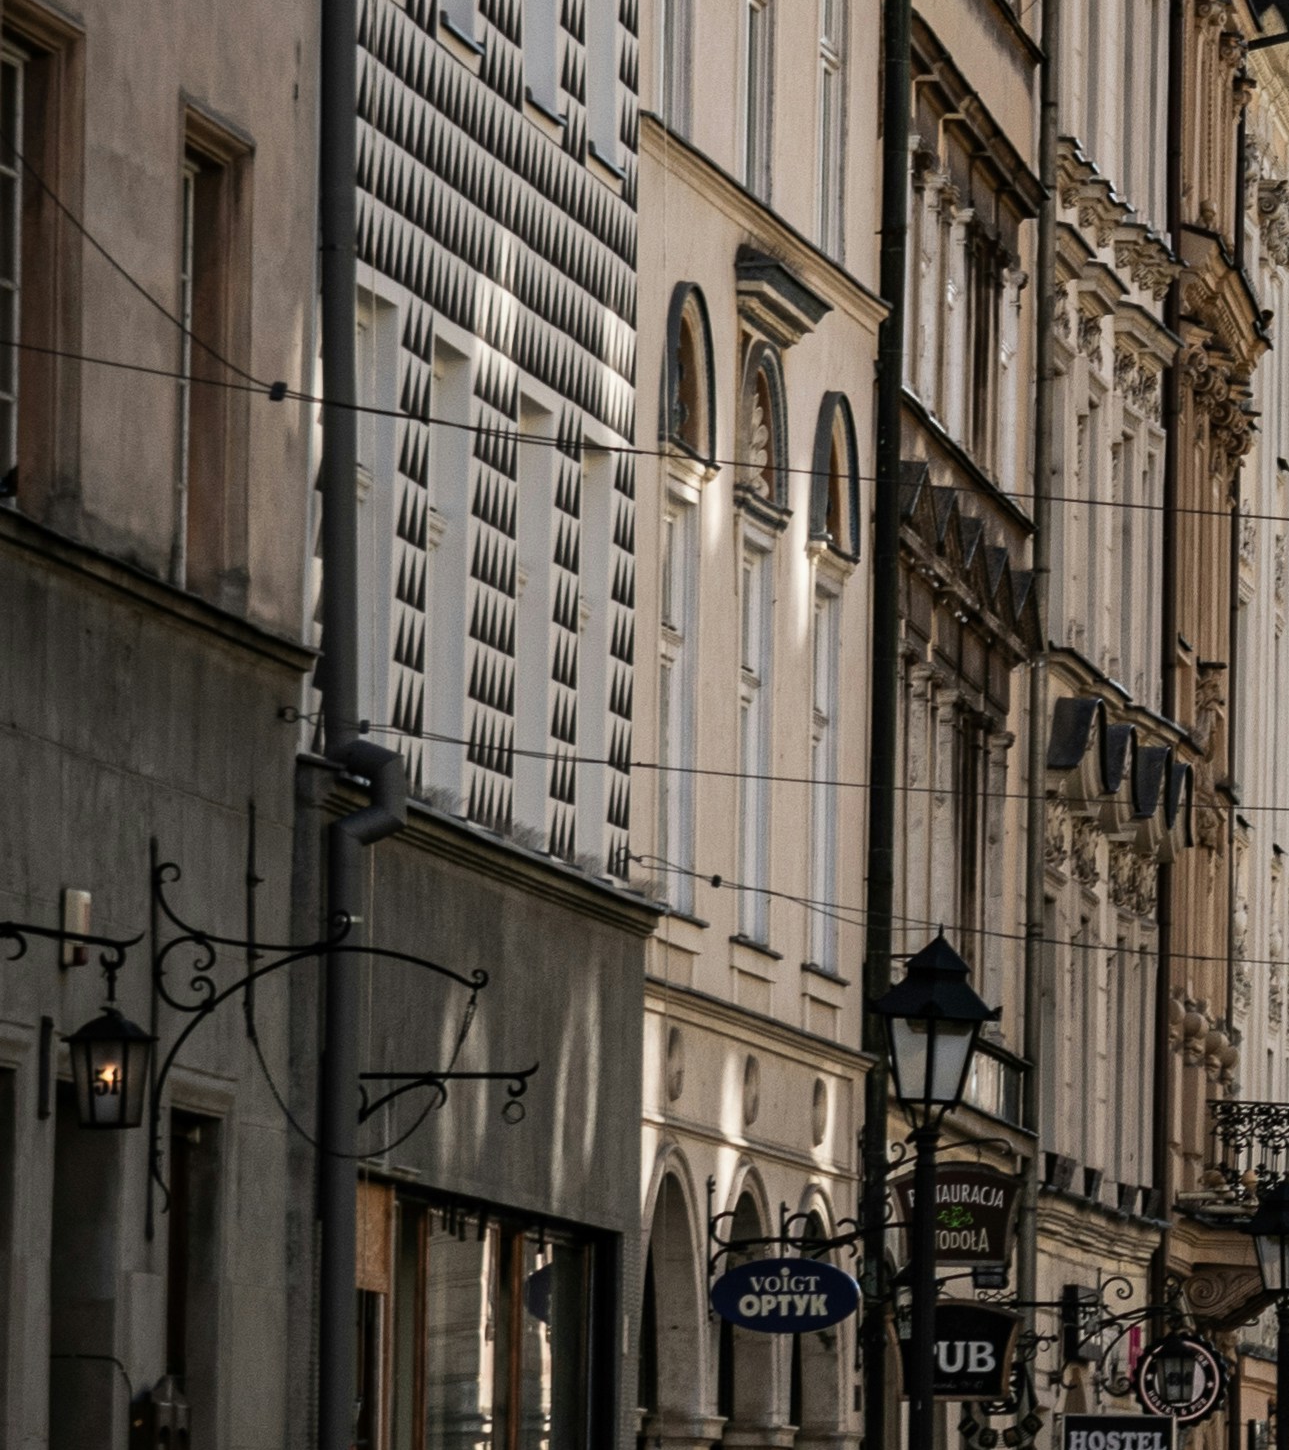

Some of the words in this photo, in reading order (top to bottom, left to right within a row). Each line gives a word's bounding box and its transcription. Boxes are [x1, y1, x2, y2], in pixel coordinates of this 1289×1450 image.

[907, 1184, 1004, 1209] RTAURACJA
[935, 1227, 989, 1253] TODOŁA
[738, 1294, 828, 1317] OPTYK
[933, 1341, 997, 1373] UB
